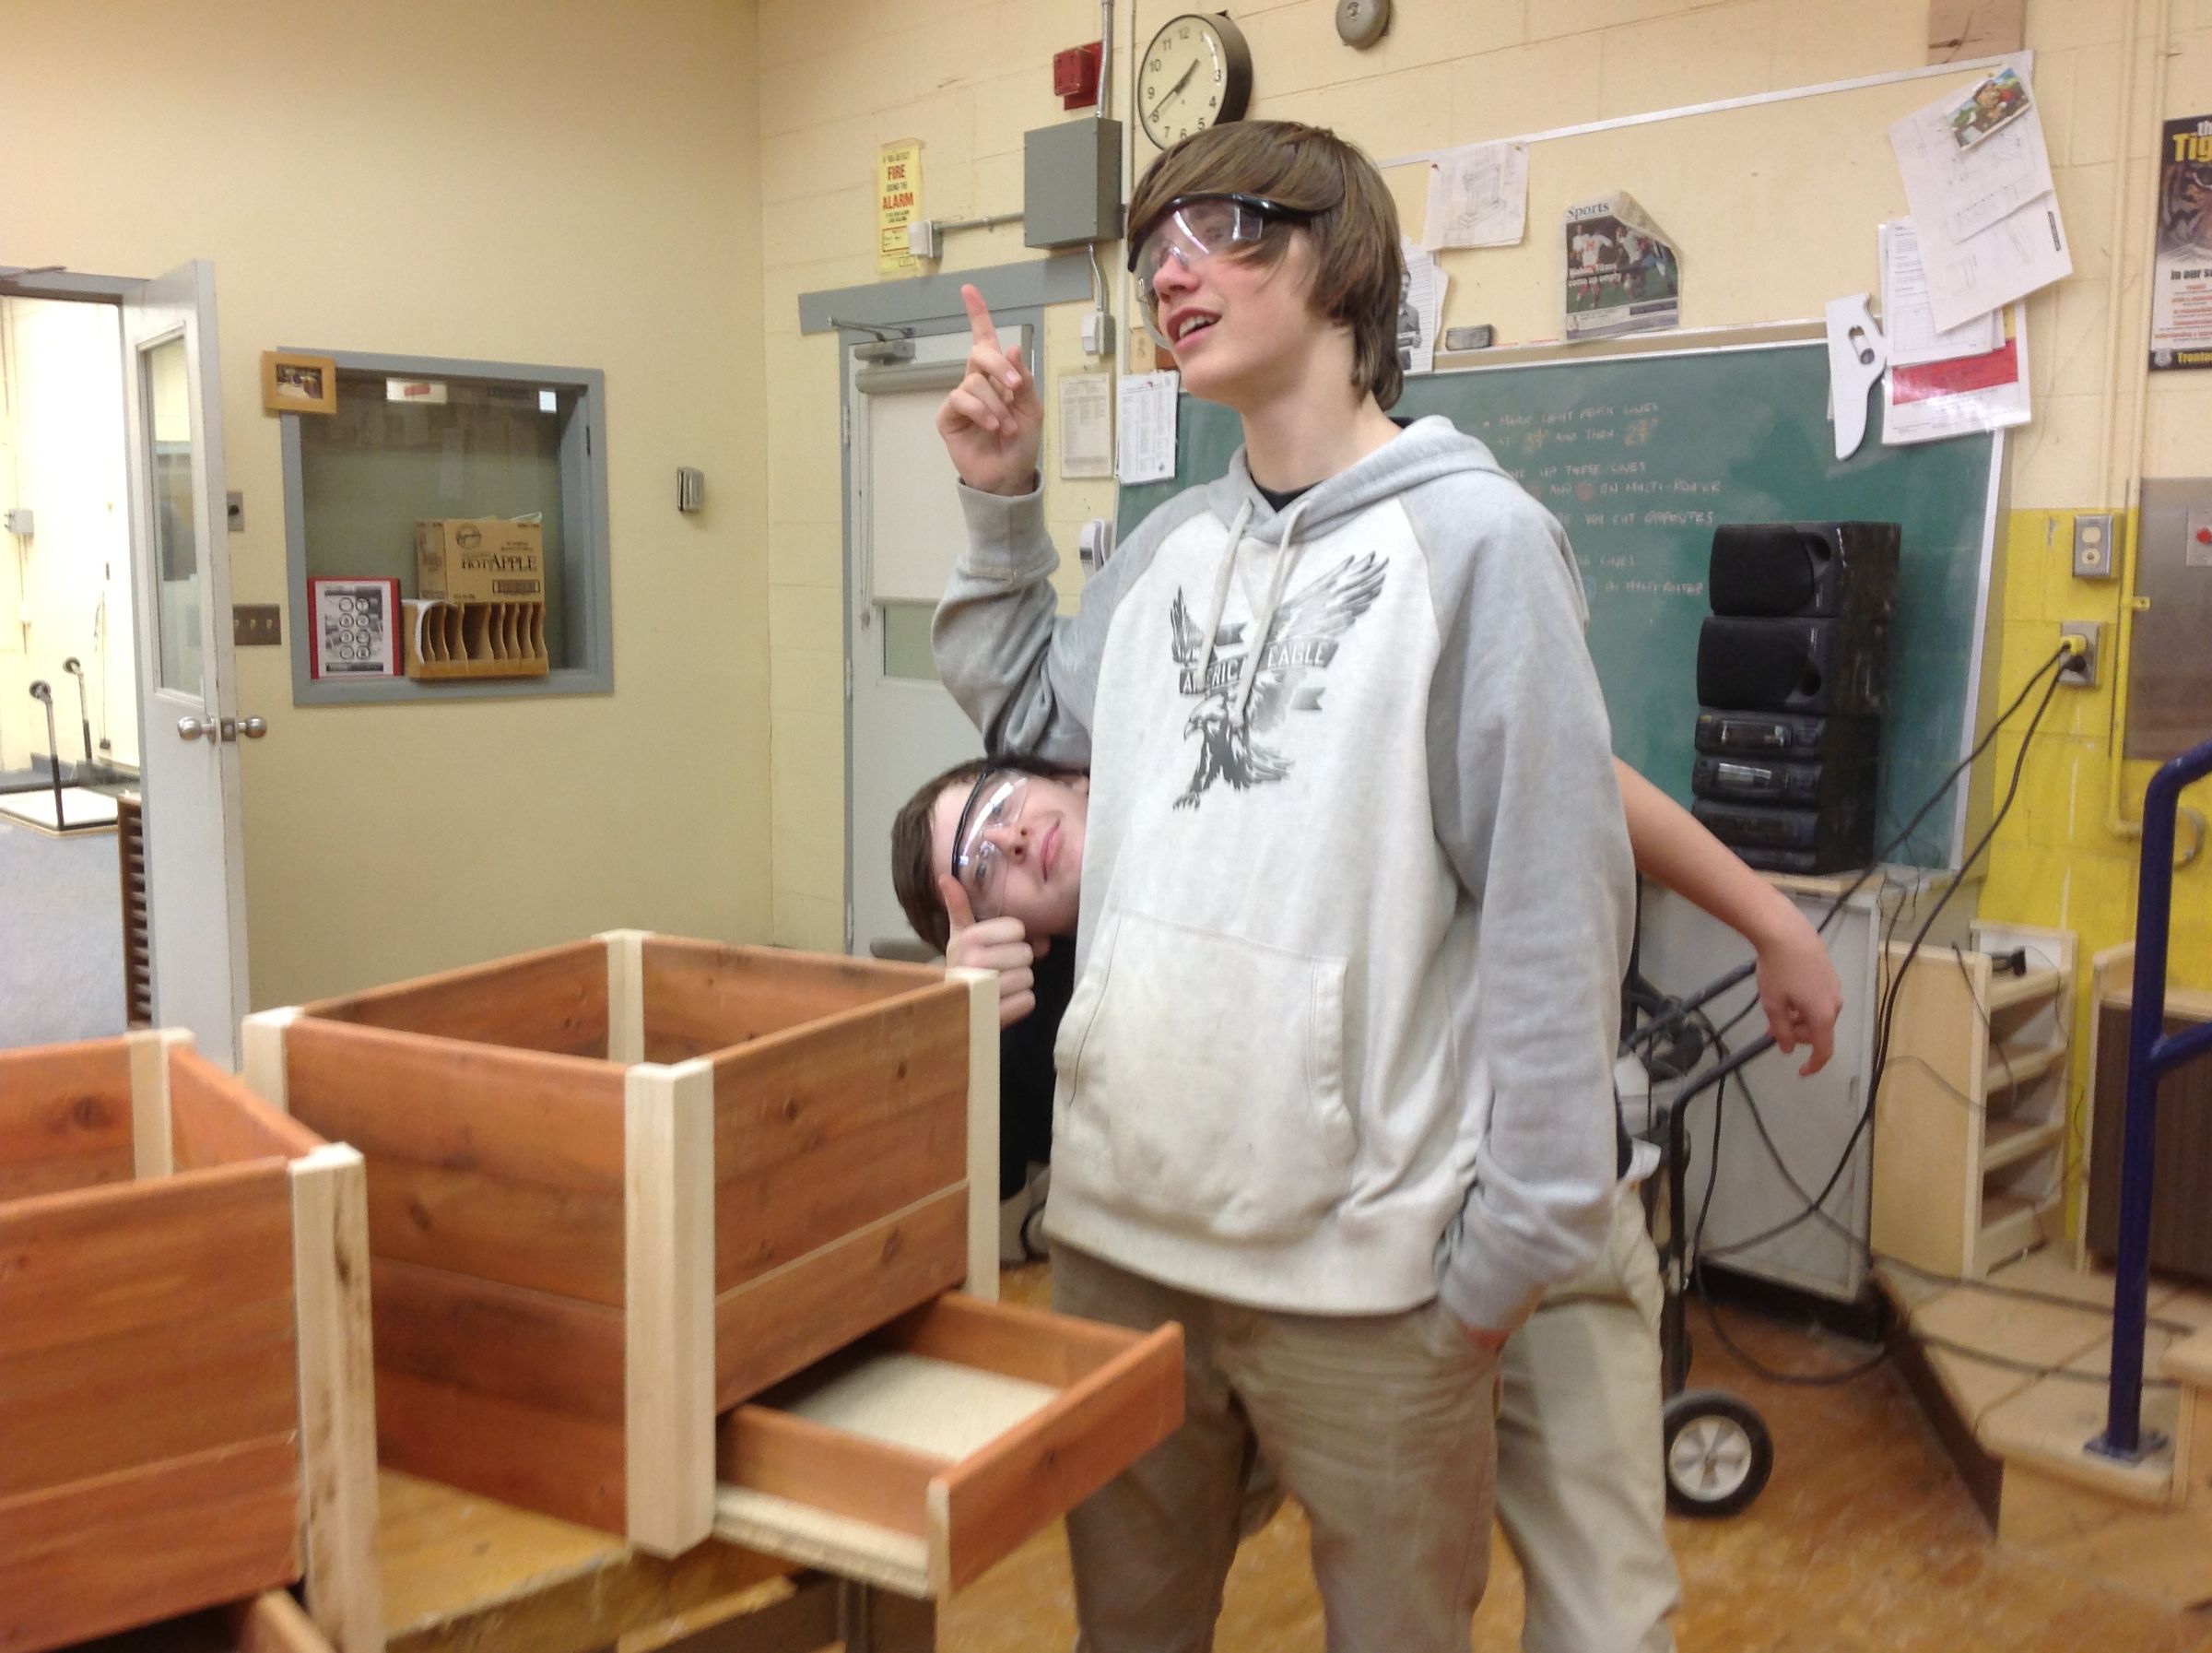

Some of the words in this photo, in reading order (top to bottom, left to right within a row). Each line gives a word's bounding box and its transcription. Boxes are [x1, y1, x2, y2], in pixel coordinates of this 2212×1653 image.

[1180, 26, 1190, 40] 12
[1162, 38, 1171, 51] 11
[1149, 59, 1162, 73] 10
[1214, 69, 1221, 82] 3
[1147, 86, 1155, 100] 9
[1209, 96, 1217, 108] 4
[1152, 110, 1159, 123] 8
[1198, 118, 1206, 130] 5
[1164, 126, 1171, 138] 7
[1180, 128, 1187, 140] 6
[888, 164, 905, 180] FIRE
[883, 193, 914, 209] ALARM
[1568, 203, 1609, 220] Sports
[1566, 464, 1601, 476] THESE
[1611, 462, 1646, 473] LINES
[461, 559, 488, 570] HOT
[492, 553, 537, 572] APPLE
[1266, 640, 1326, 669] EAGLE
